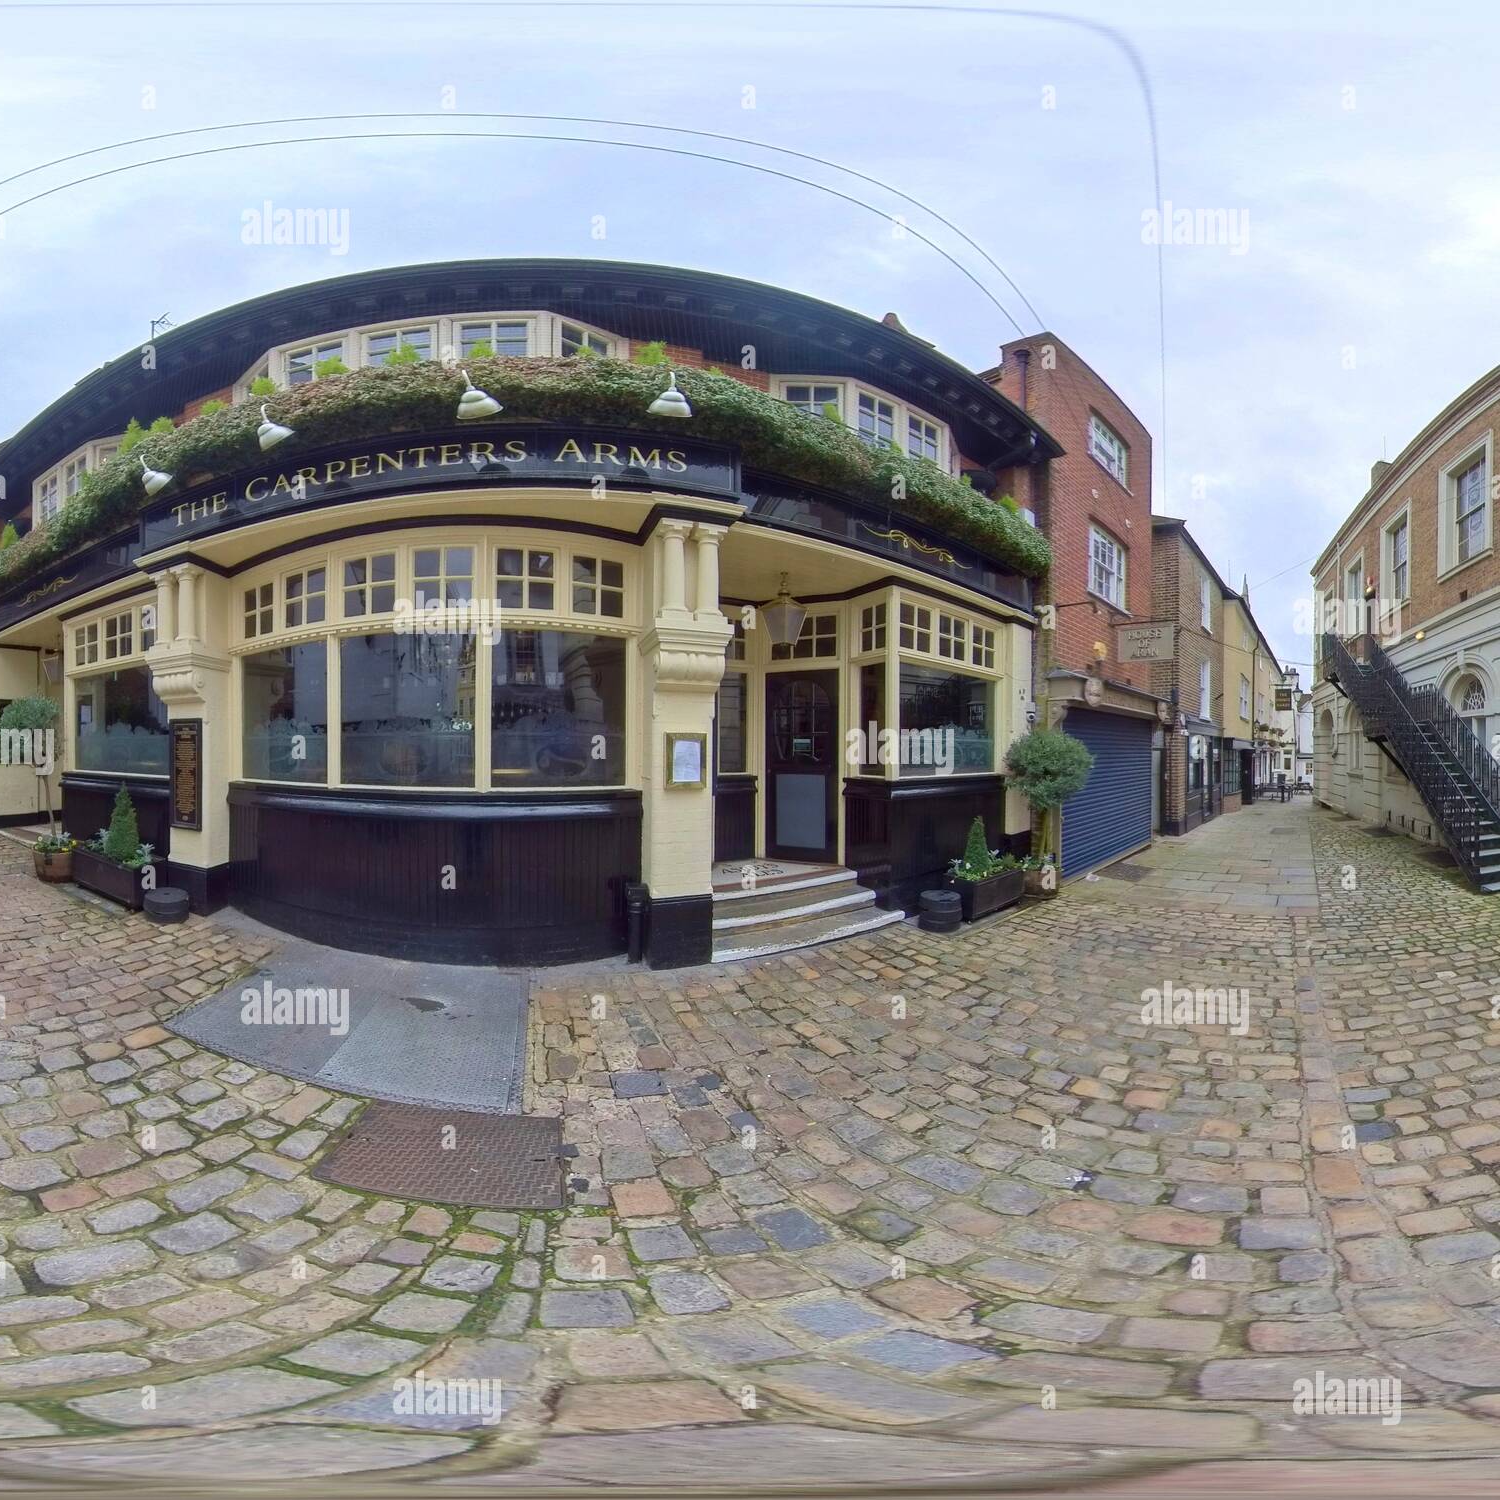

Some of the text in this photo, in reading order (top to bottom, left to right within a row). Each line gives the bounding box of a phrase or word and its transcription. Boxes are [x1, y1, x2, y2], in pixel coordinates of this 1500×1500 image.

[170, 438, 689, 528] THE CARPENTERS ARMS
[1138, 639, 1151, 649] OF
